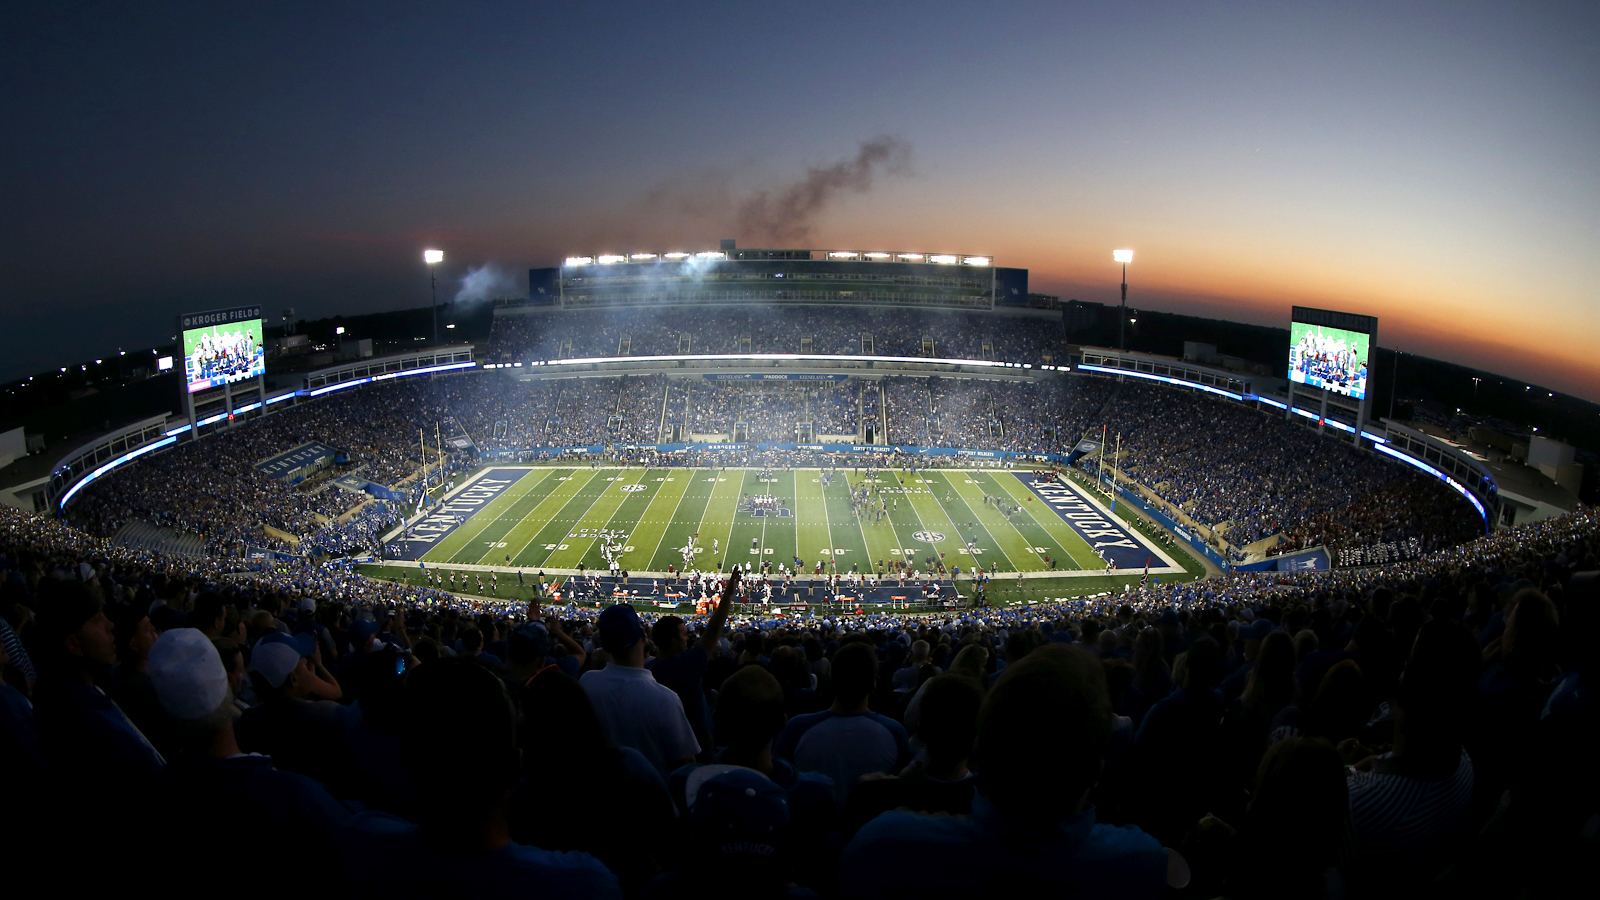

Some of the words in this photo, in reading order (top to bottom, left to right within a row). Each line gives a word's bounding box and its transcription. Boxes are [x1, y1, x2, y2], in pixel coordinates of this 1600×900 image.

[192, 312, 227, 326] KROGER
[230, 309, 253, 320] FIELD
[261, 445, 326, 475] KENTUCKY
[397, 478, 512, 543] KENTUCKY
[1028, 481, 1140, 549] KENTUCKY
